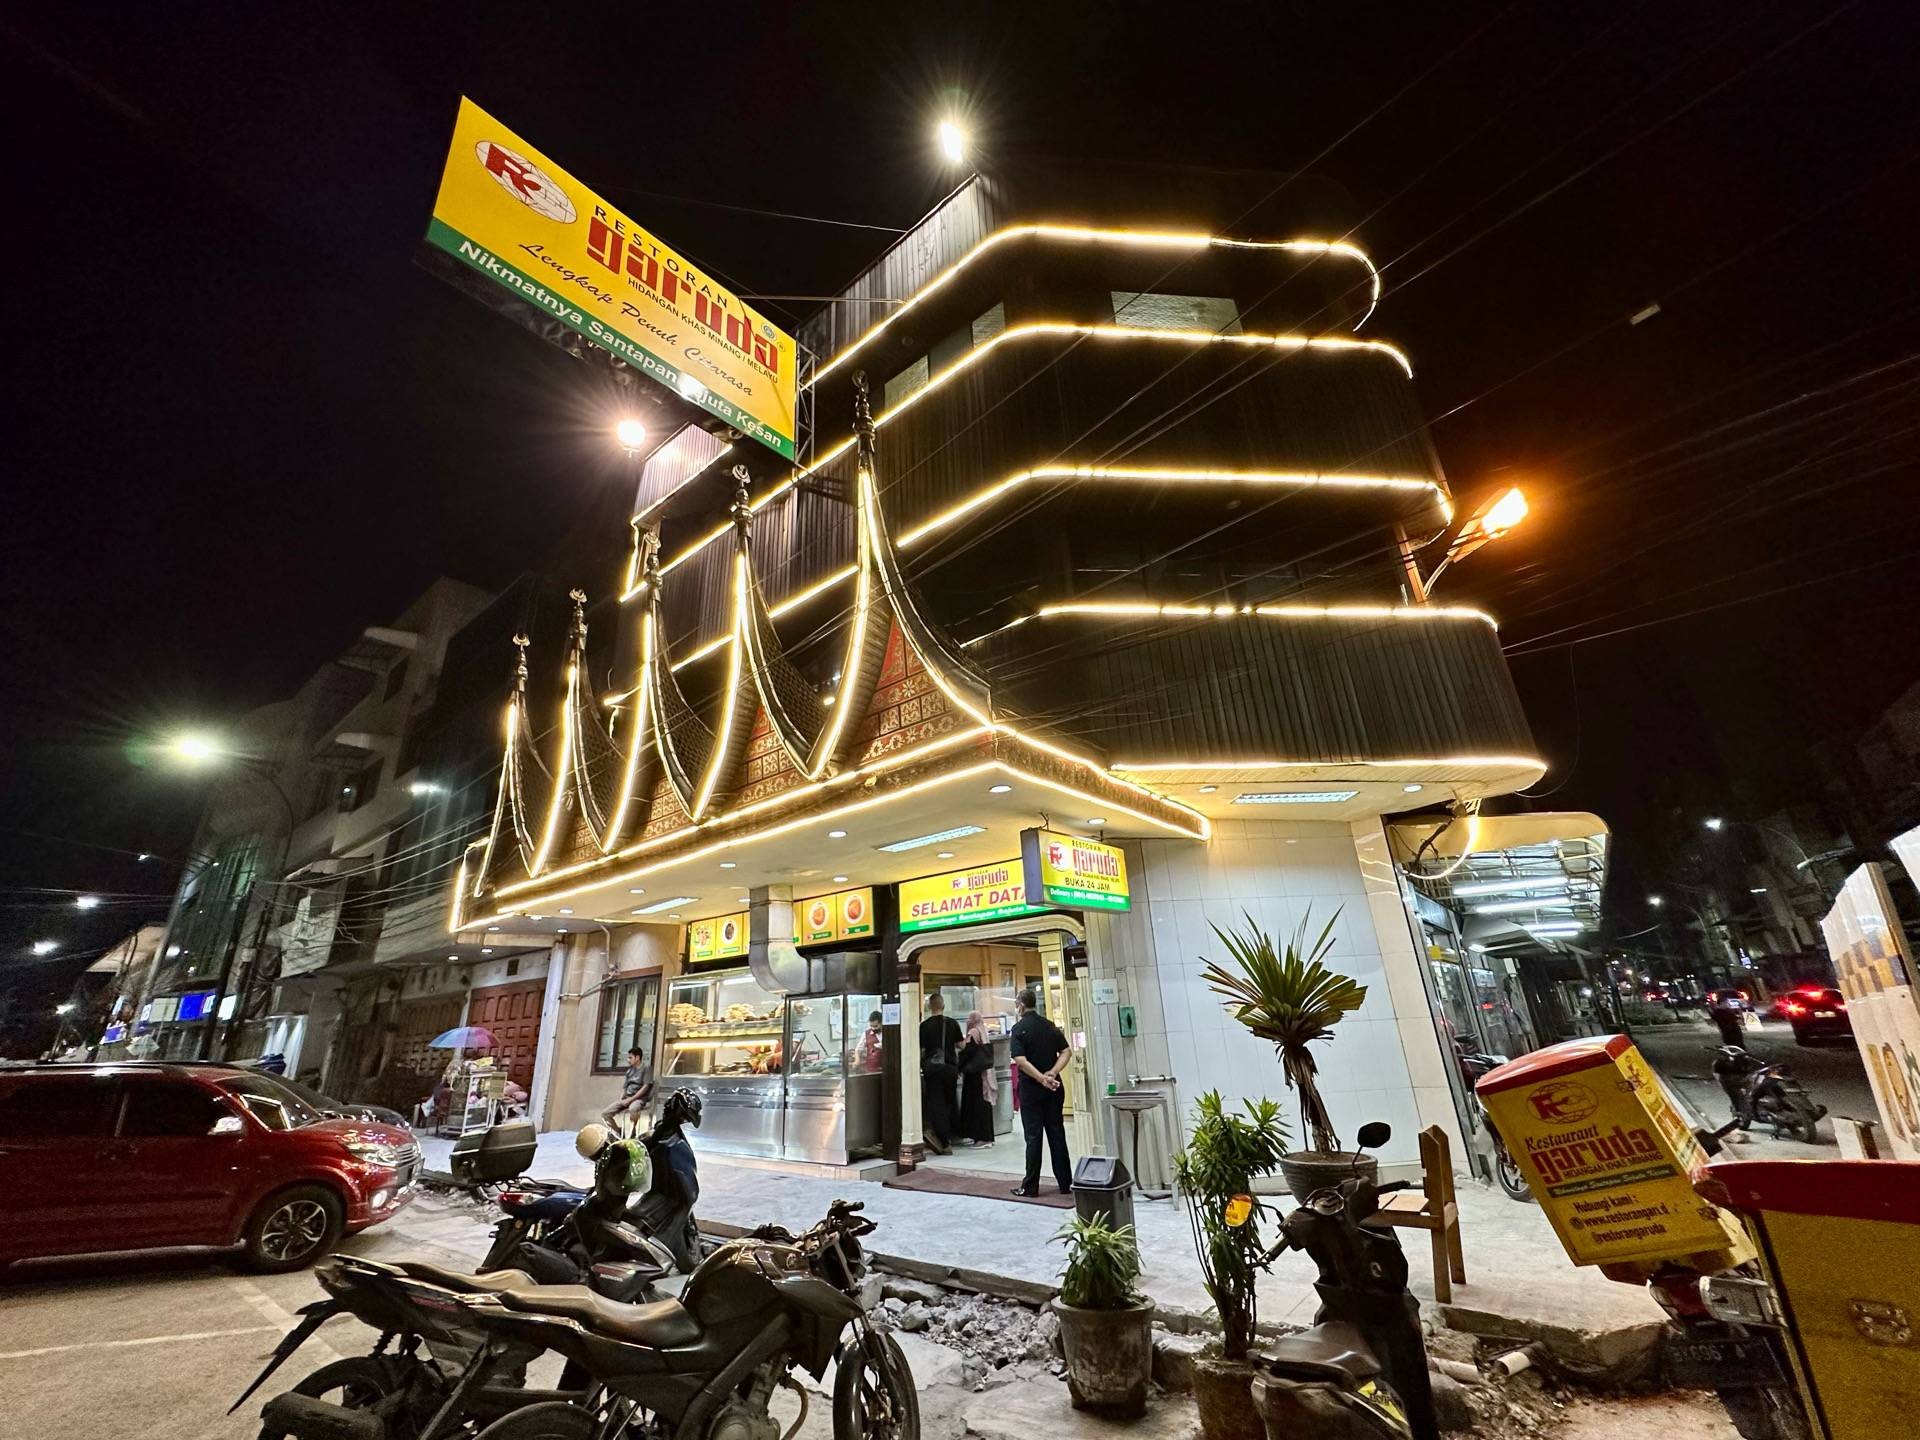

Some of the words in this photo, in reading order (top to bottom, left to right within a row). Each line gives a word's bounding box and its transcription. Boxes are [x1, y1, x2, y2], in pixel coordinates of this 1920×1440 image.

[594, 204, 728, 308] RESTORAN
[519, 242, 614, 304] Lengkap
[621, 301, 677, 347] Penuh
[586, 216, 778, 374] garuda
[458, 240, 584, 325] Nikmatnya
[587, 321, 678, 385] Santapan
[735, 410, 782, 448] Kesan
[627, 277, 679, 318] HIDANGAN
[681, 313, 706, 336] KHAS
[708, 332, 742, 359] MINANG
[746, 358, 779, 384] MELAYU
[967, 867, 1009, 891] garuda
[1065, 877, 1085, 888] BUKA
[1087, 880, 1095, 889] 24
[1097, 882, 1111, 892] JAM
[1073, 848, 1119, 877] garuda
[911, 892, 984, 918] SELAMAT
[1524, 1124, 1599, 1152] Restaurant
[1530, 1124, 1658, 1185] garuda
